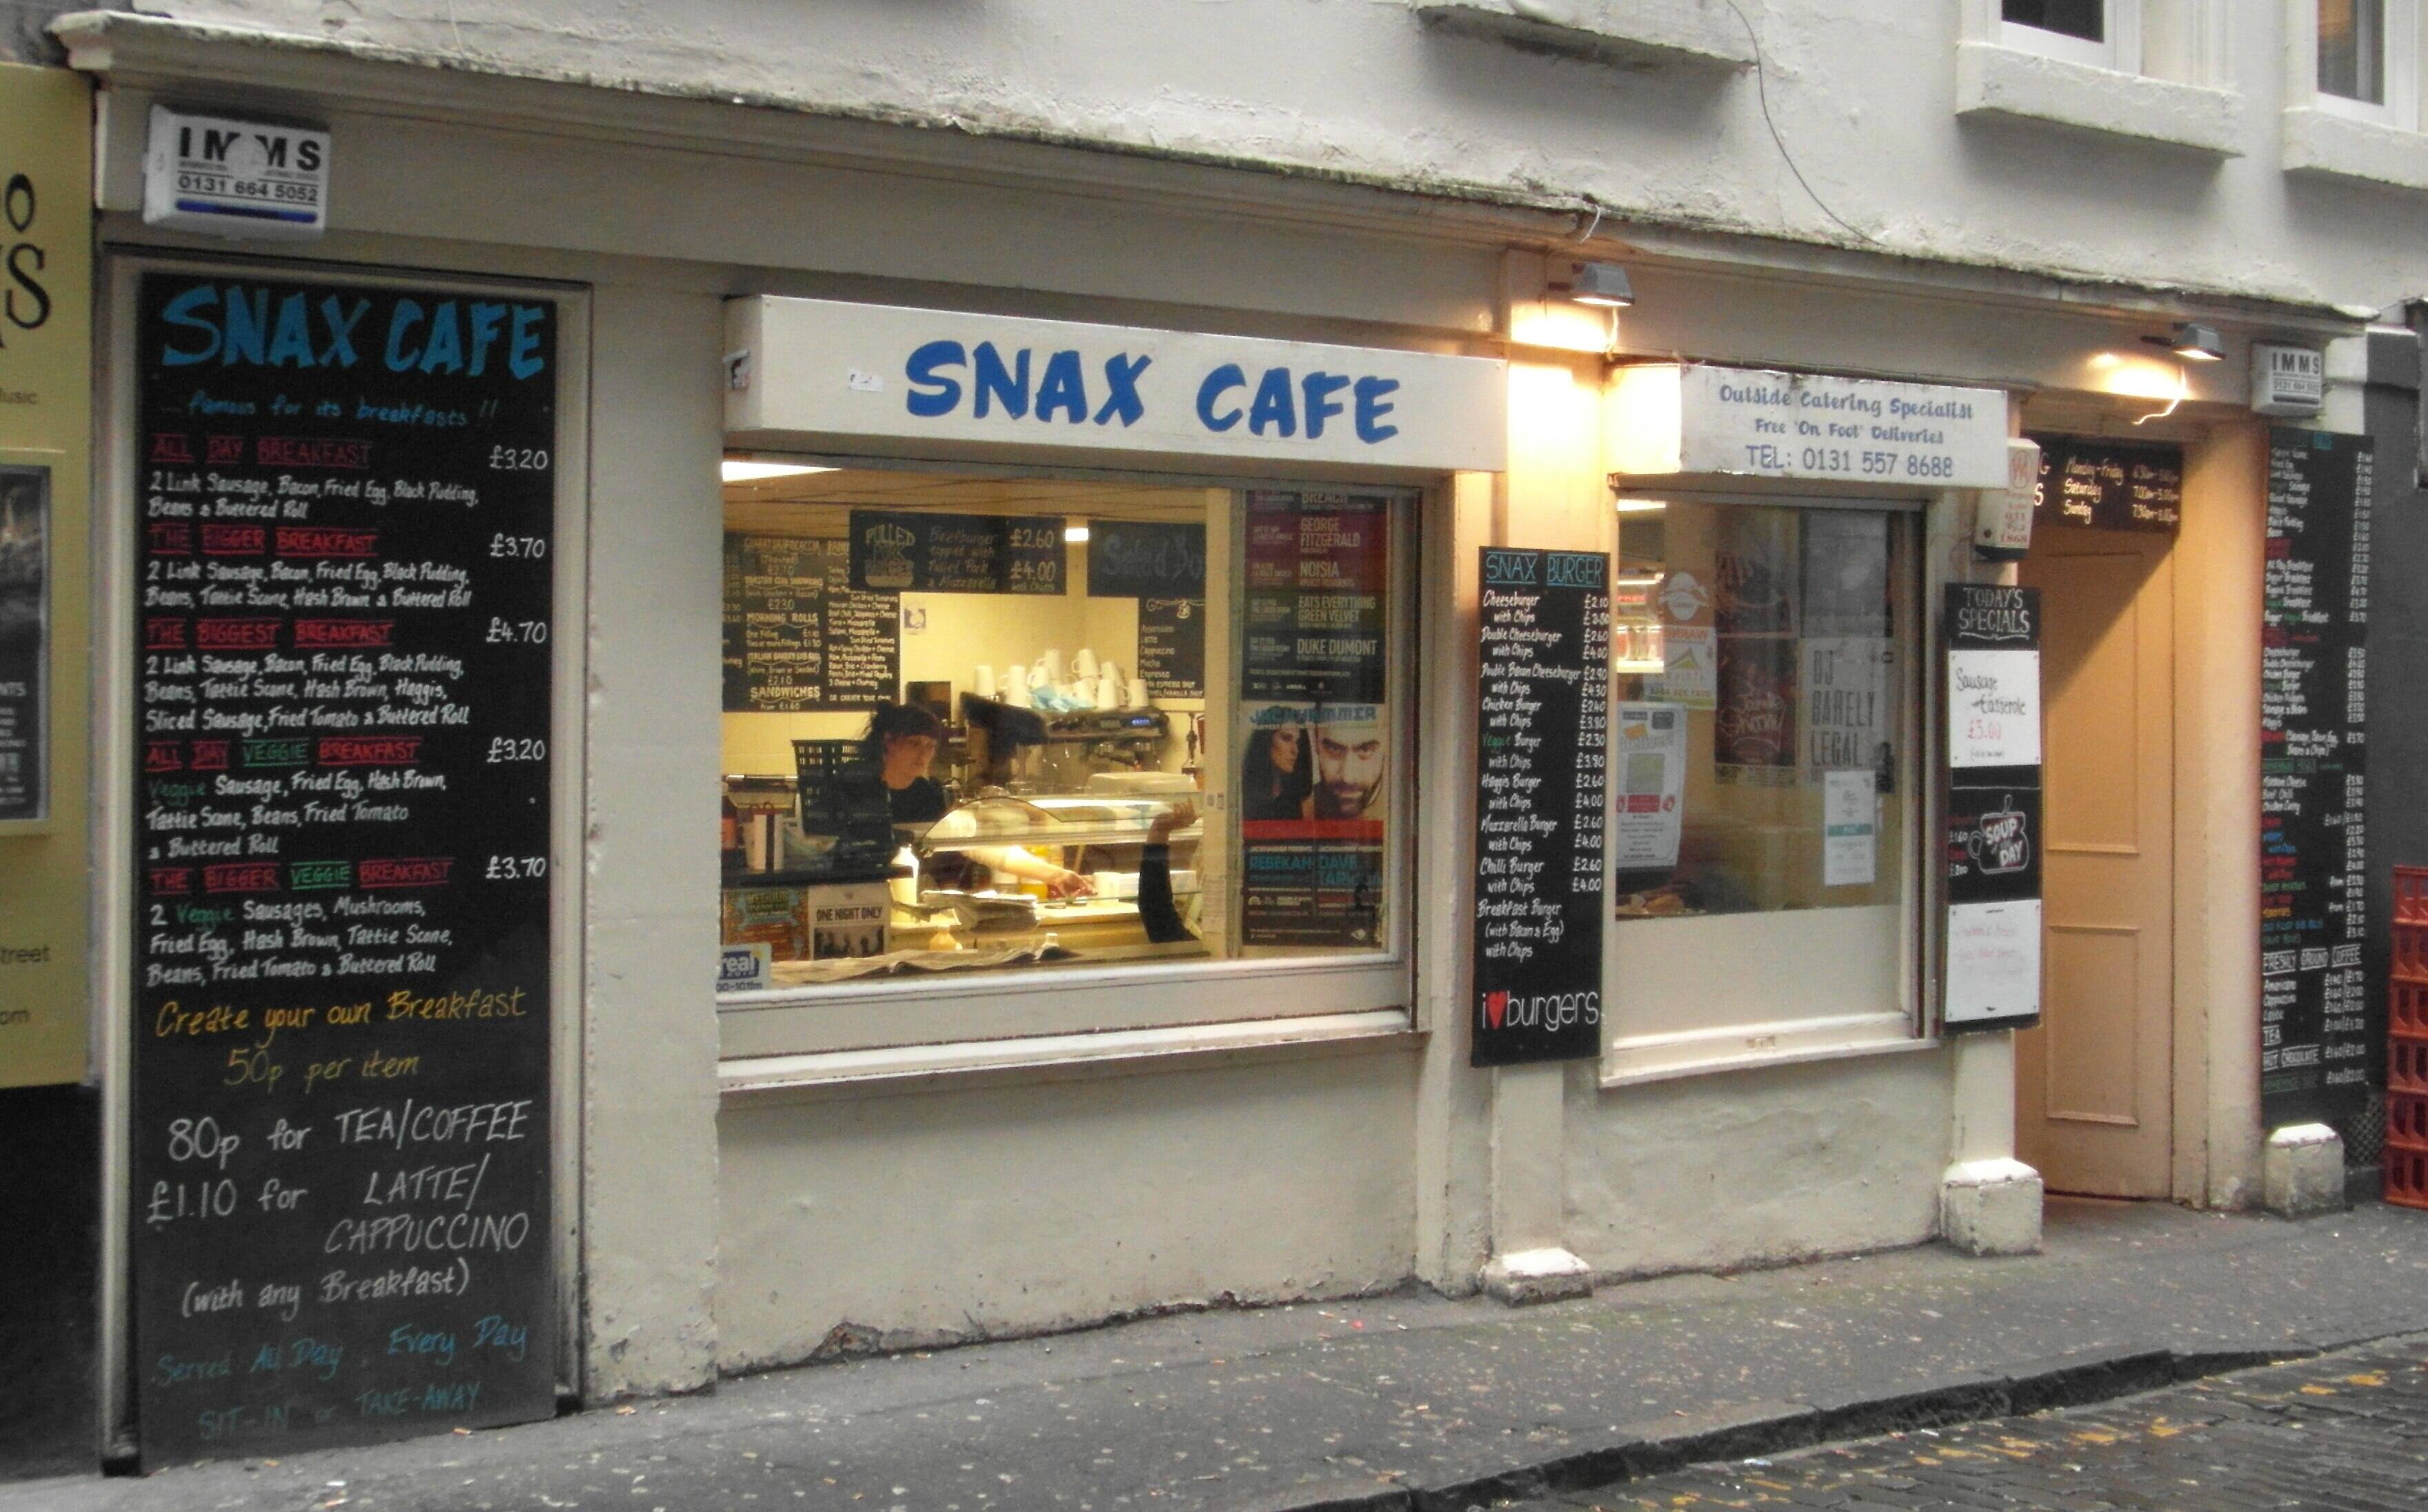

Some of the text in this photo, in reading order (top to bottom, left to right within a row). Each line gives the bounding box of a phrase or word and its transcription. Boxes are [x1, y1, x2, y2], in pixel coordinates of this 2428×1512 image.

[179, 176, 317, 202] 0131 664 5052
[161, 284, 545, 380] SNAX CAFE
[2273, 352, 2320, 374] IMMS
[905, 340, 1400, 444] SNAX CAFE
[1720, 384, 1974, 420] Outside Catering Specialist
[1755, 418, 1787, 435] Free
[1871, 425, 1943, 444] Deliveries
[152, 435, 548, 470] ALL DAY BREAKFAST £3.20
[1746, 444, 1953, 478] TEL: 0131 557 8688
[2064, 478, 2102, 503] Saturday
[2064, 499, 2091, 524] Sunday
[865, 524, 915, 546] PULLED
[1011, 528, 1055, 548] £2.60
[1300, 517, 1340, 532] GEORGE
[276, 528, 377, 557] BREAKFAST
[490, 533, 544, 559] £3.70
[1300, 533, 1360, 548] FITZGERALD
[1011, 561, 1056, 582] £4.00
[1299, 561, 1340, 577] NOISIA
[1486, 555, 1603, 584] SNAX BURGER
[1299, 596, 1376, 609] EATS EVERYTHING
[1484, 590, 1609, 613] Cheeseburger £2.10
[1964, 587, 2024, 609] TODAY'S
[792, 613, 818, 623] ROLLS
[1959, 608, 2030, 633] SPECIALS
[145, 617, 546, 649] THE BIGGEST BREAKFAST £4.70
[1297, 639, 1326, 654] DUKE
[1329, 639, 1377, 655] DUMONT
[750, 686, 820, 699] SANDWICHES
[1956, 667, 1998, 695] Sausage
[1812, 690, 1876, 726] BARELY
[1515, 731, 1542, 752] Burger
[1578, 731, 1605, 746] £2.30
[1811, 730, 1862, 766] LEGAL
[145, 737, 544, 772] ALL DAY VEGGIE BREAKFAST £3.20
[1482, 773, 1604, 795] Haggis Burger £2.60
[1489, 793, 1603, 815] with Chips £4.00
[1985, 818, 2018, 845] SOUP
[2000, 840, 2023, 866] DAY
[150, 857, 546, 895] THE BIGGER VEGGIE BREAKFAST £3.70
[1509, 857, 1544, 880] Burger
[1573, 857, 1602, 872] £2.60
[1488, 877, 1602, 897] with Chips £4.00
[816, 906, 883, 921] ONE NIGHT ONLY
[1477, 898, 1562, 920] Breakfast Burger
[2300, 951, 2329, 967] GROUND
[2332, 946, 2361, 966] COFFEE
[156, 986, 526, 1048] Create your own Breakfast
[1507, 991, 1599, 1031] burgers
[2263, 1028, 2280, 1045] TEA
[2281, 1048, 2319, 1066] CHOCOLATE
[223, 1050, 419, 1094] 50p per item
[168, 1100, 533, 1168] 80p for TEA/COFFEE
[148, 1153, 490, 1224] £1.10 for LATTE/
[324, 1213, 530, 1253] CAPPUCCINO
[182, 1257, 470, 1322] (with any Breakfast)
[290, 1315, 527, 1380] Day Every Day
